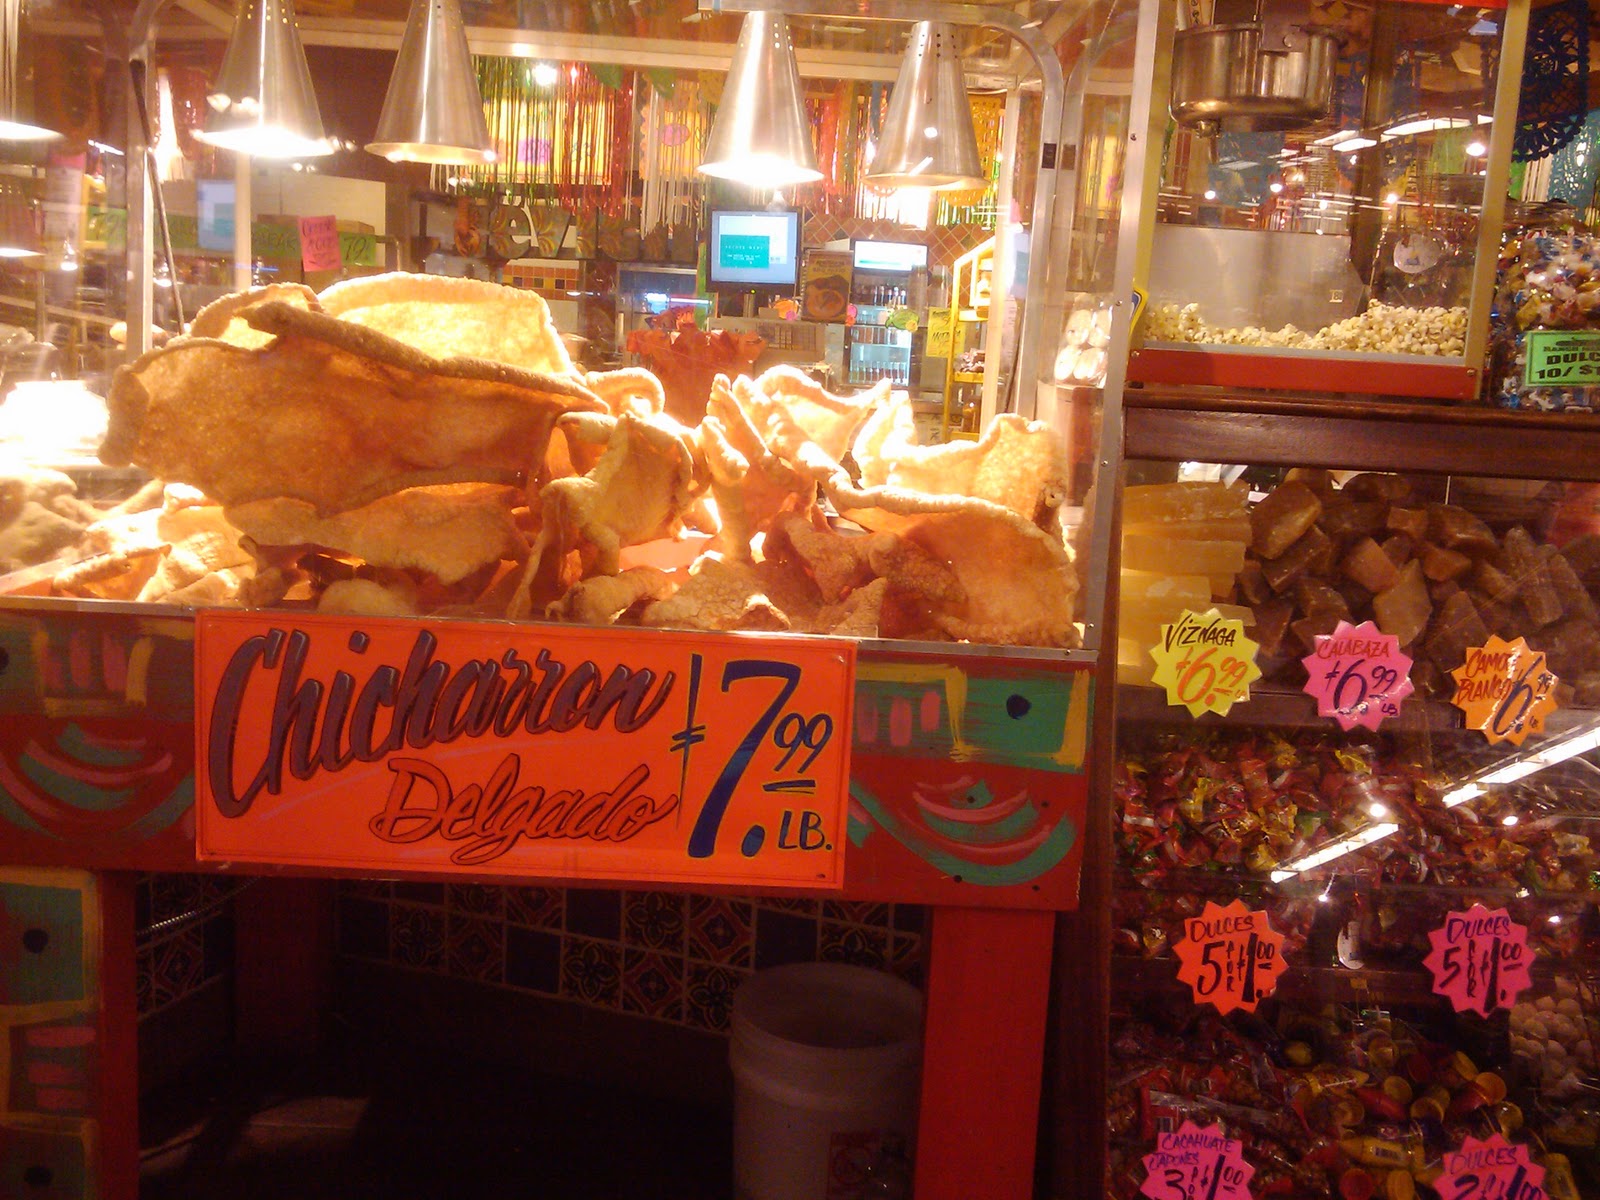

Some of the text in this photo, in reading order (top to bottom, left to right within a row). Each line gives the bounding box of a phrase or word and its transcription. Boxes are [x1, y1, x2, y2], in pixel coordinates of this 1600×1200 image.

[1316, 639, 1390, 660] CALABAZA
[208, 628, 676, 819] Chicharron
[368, 753, 678, 867] Delgado
[1189, 915, 1255, 943] DULCES
[1446, 915, 1511, 944] DULCES
[1196, 940, 1226, 996] 5
[1438, 946, 1462, 989] 5
[1161, 1132, 1236, 1154] CACAHUATE
[1449, 1145, 1518, 1175] DULCES
